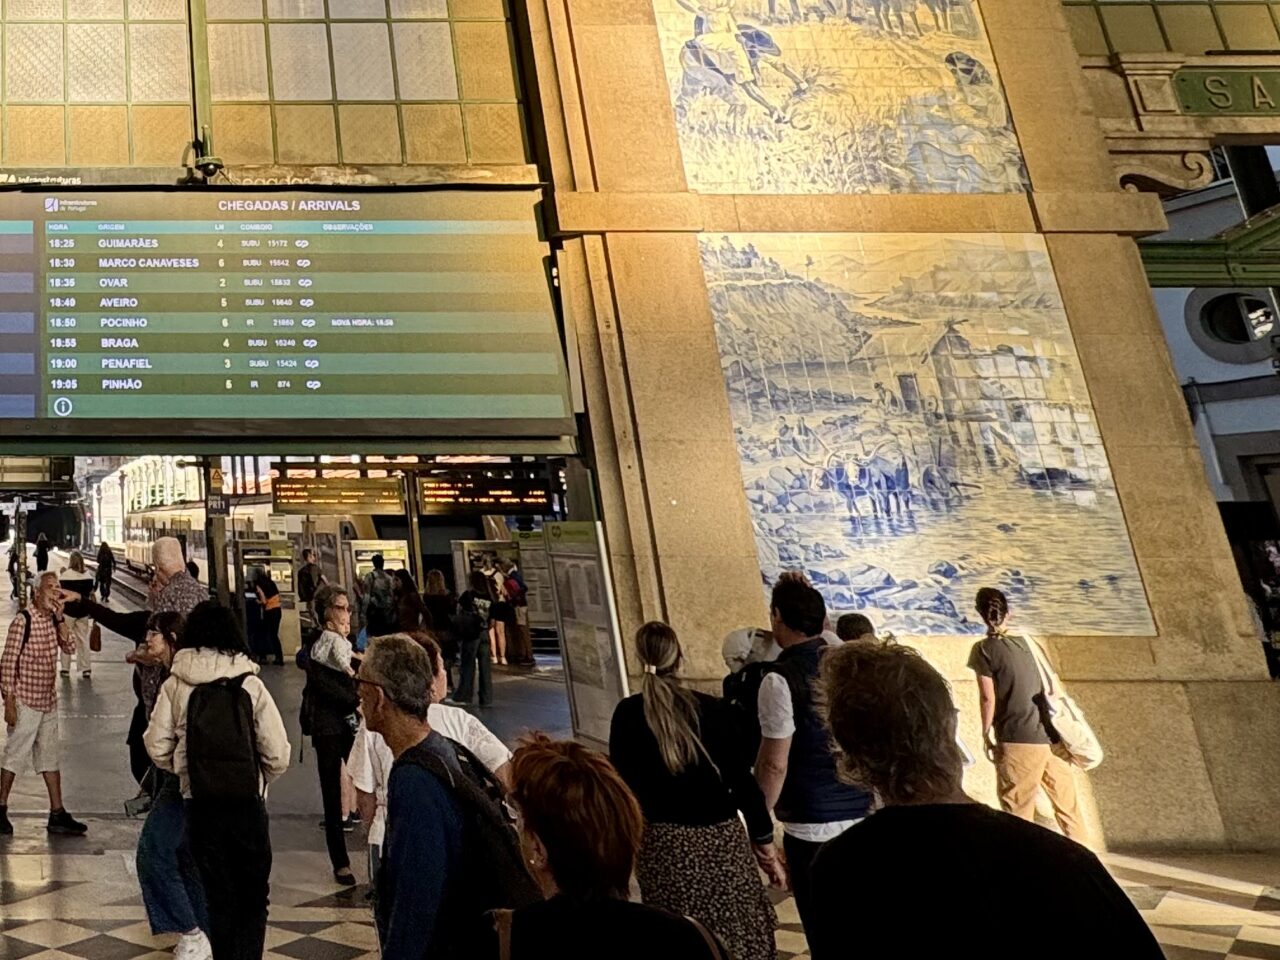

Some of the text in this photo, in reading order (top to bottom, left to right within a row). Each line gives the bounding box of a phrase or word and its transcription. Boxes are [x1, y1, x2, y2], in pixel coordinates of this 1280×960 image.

[218, 200, 360, 210] CHEGADAS / ARRIVALS
[48, 239, 74, 248] 18:25
[98, 238, 158, 247] GUIMARÃES
[217, 239, 223, 248] 4
[49, 259, 74, 268] 18:30
[98, 259, 138, 268] MARCO
[140, 259, 199, 268] CANAVESES
[49, 278, 75, 287] 18:35
[99, 279, 127, 288] OVAR
[219, 279, 225, 287] 2
[49, 298, 75, 307] 18:40
[99, 298, 138, 307] AVEIRO
[49, 318, 76, 327] 18:50
[100, 318, 147, 327] POCINHO
[50, 338, 76, 347] 18:55
[100, 338, 138, 347] BRAGA
[223, 339, 229, 348] 4
[50, 359, 76, 368] 19:00
[101, 359, 152, 368] PENAFIEL
[224, 359, 230, 368] 3
[51, 380, 77, 389] 19:05
[101, 379, 142, 389] PINHÃO
